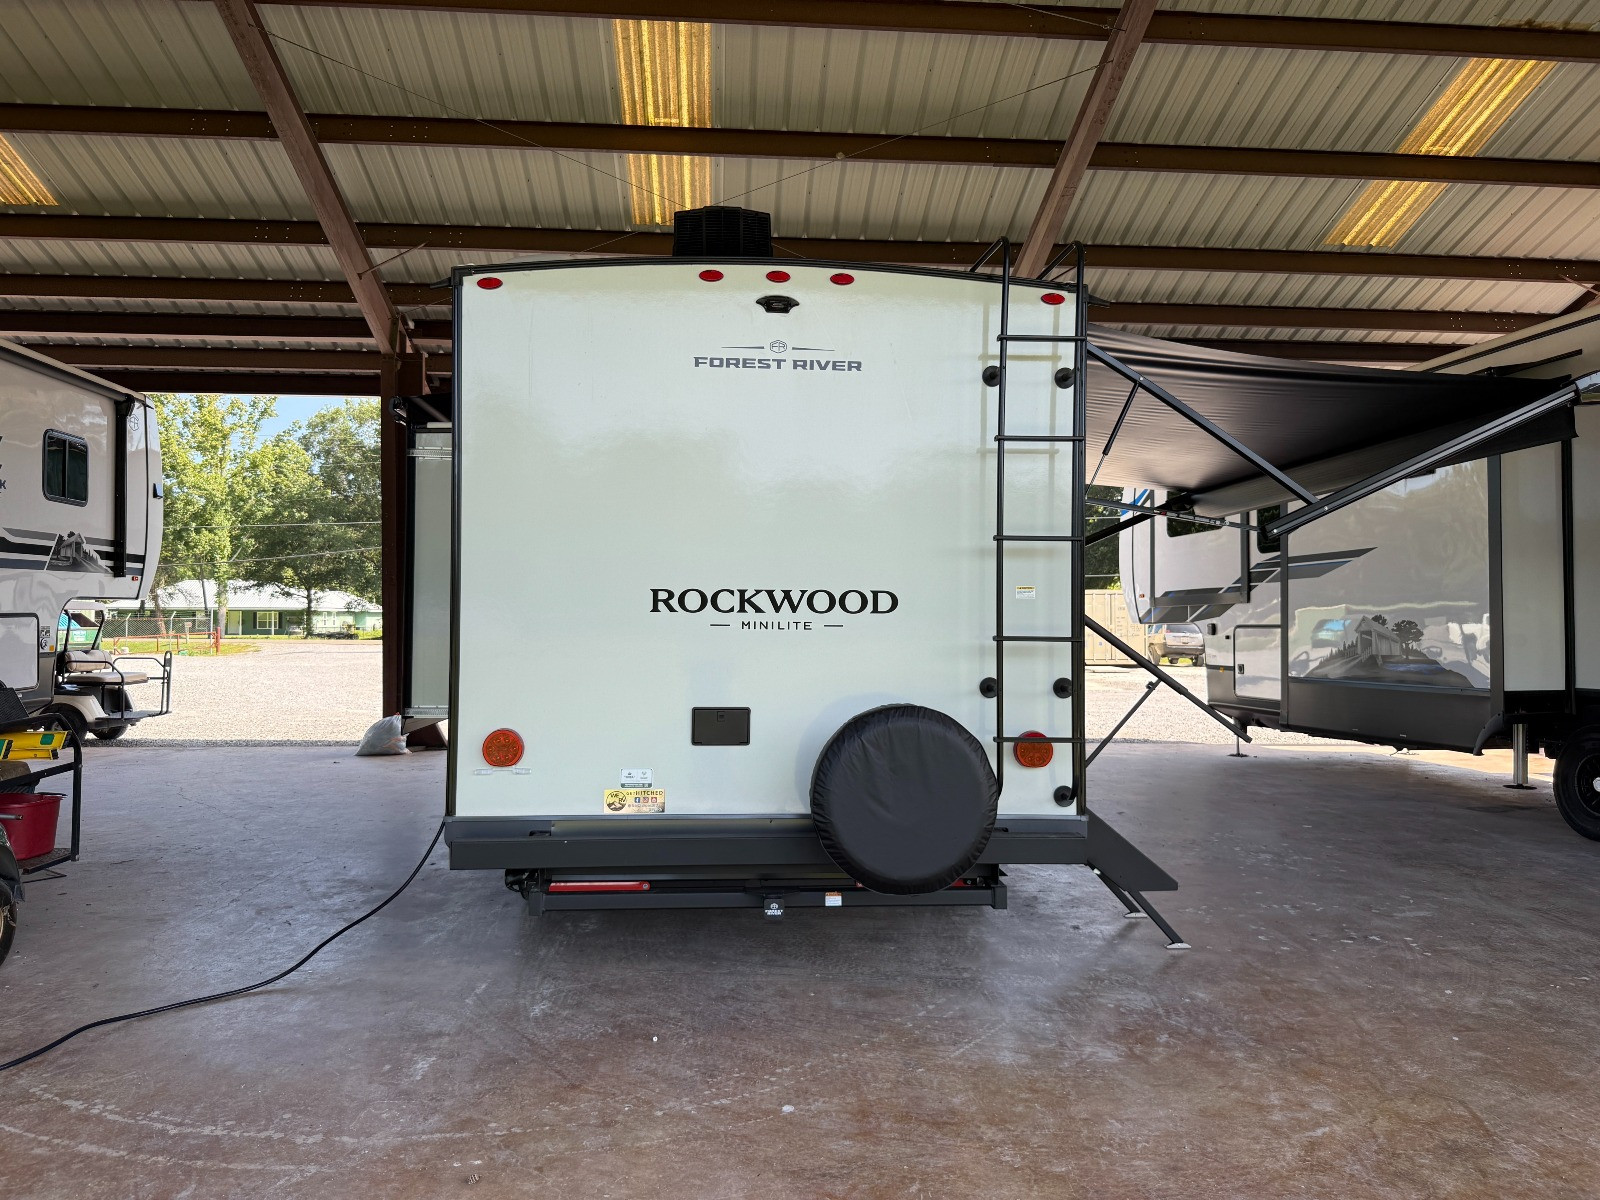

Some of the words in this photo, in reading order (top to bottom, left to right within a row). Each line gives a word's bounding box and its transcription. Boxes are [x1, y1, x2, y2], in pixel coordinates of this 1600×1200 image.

[693, 356, 786, 370] FOREST
[792, 359, 862, 372] RIVER
[650, 588, 899, 614] ROCKWOOD
[741, 620, 813, 631] MINILITE
